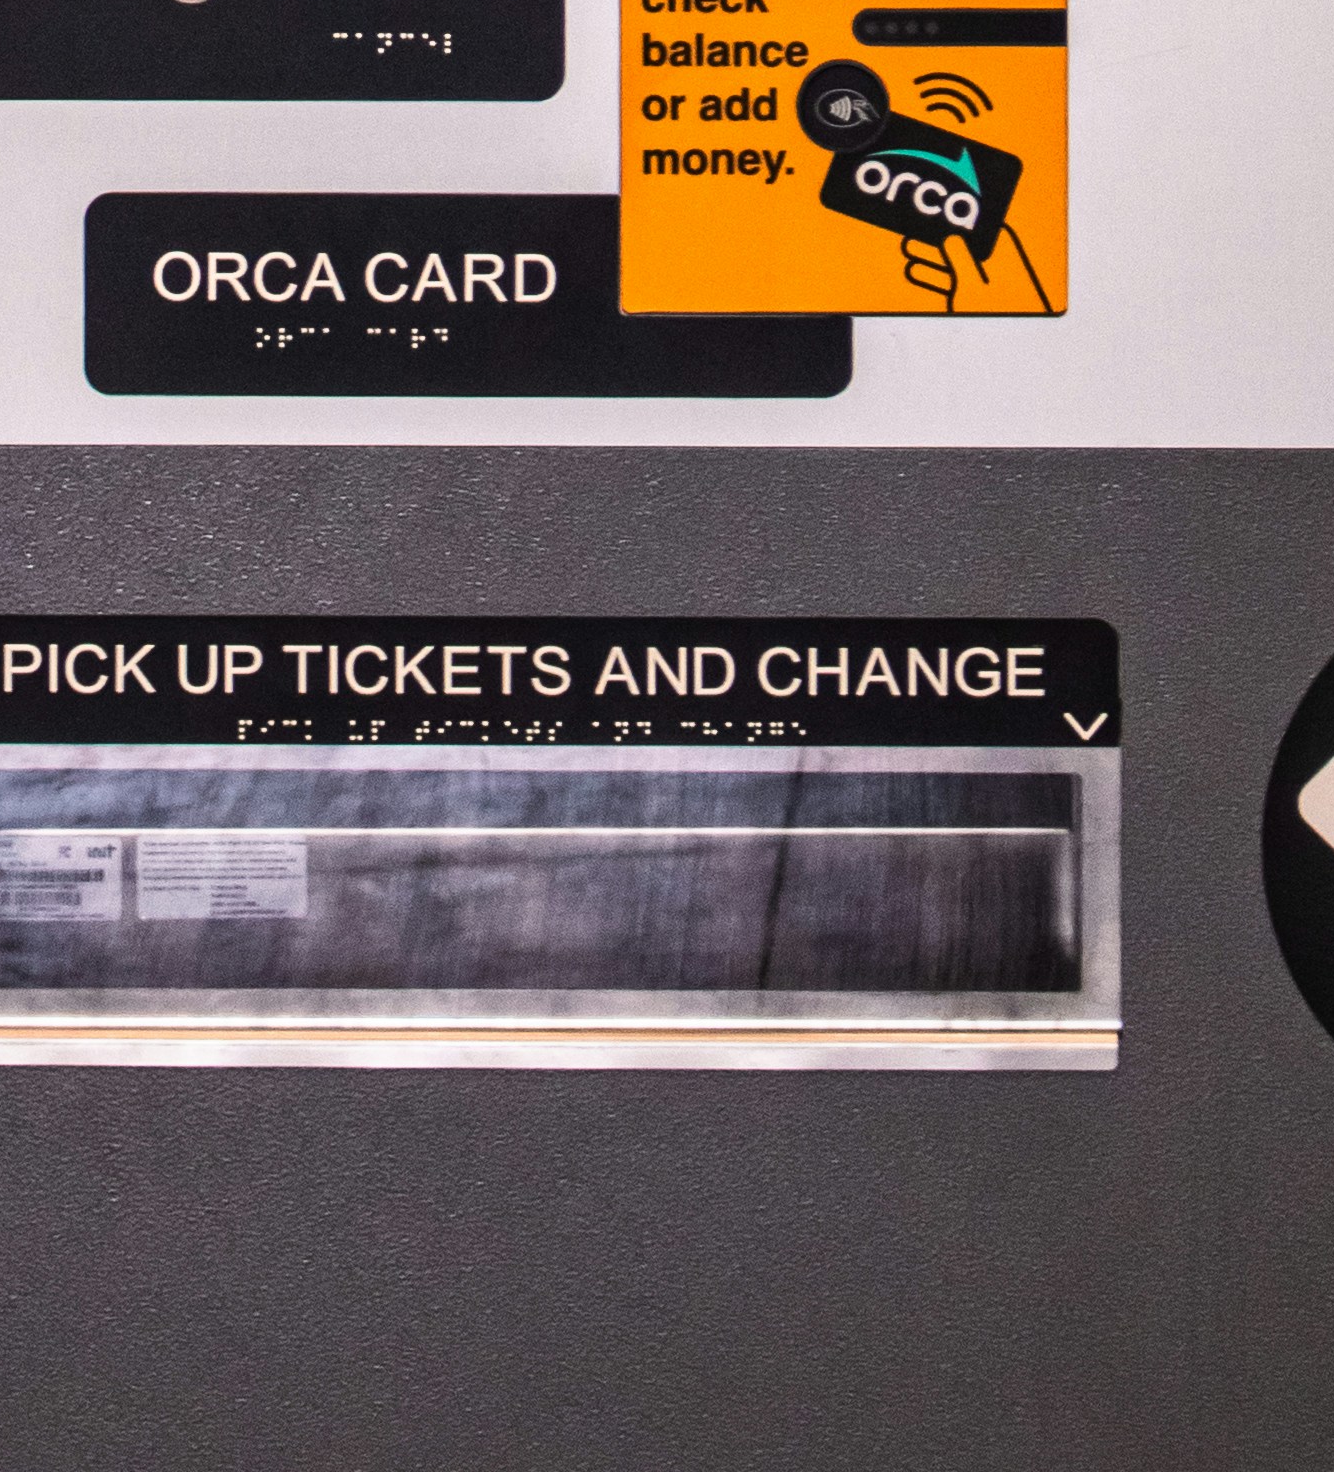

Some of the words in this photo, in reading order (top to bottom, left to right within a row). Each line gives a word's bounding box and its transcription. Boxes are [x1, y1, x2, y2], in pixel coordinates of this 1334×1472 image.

[642, 33, 807, 67] balance
[642, 95, 686, 121] or
[699, 88, 777, 121] add
[643, 149, 794, 192] money.
[855, 160, 979, 230] orca
[154, 251, 345, 302] ORCA
[365, 252, 556, 302] CARD
[4, 644, 156, 693] PICK
[178, 645, 262, 694] UP
[283, 645, 571, 695] TICKETS
[595, 647, 735, 695] AND
[758, 647, 1045, 696] CHANGE
